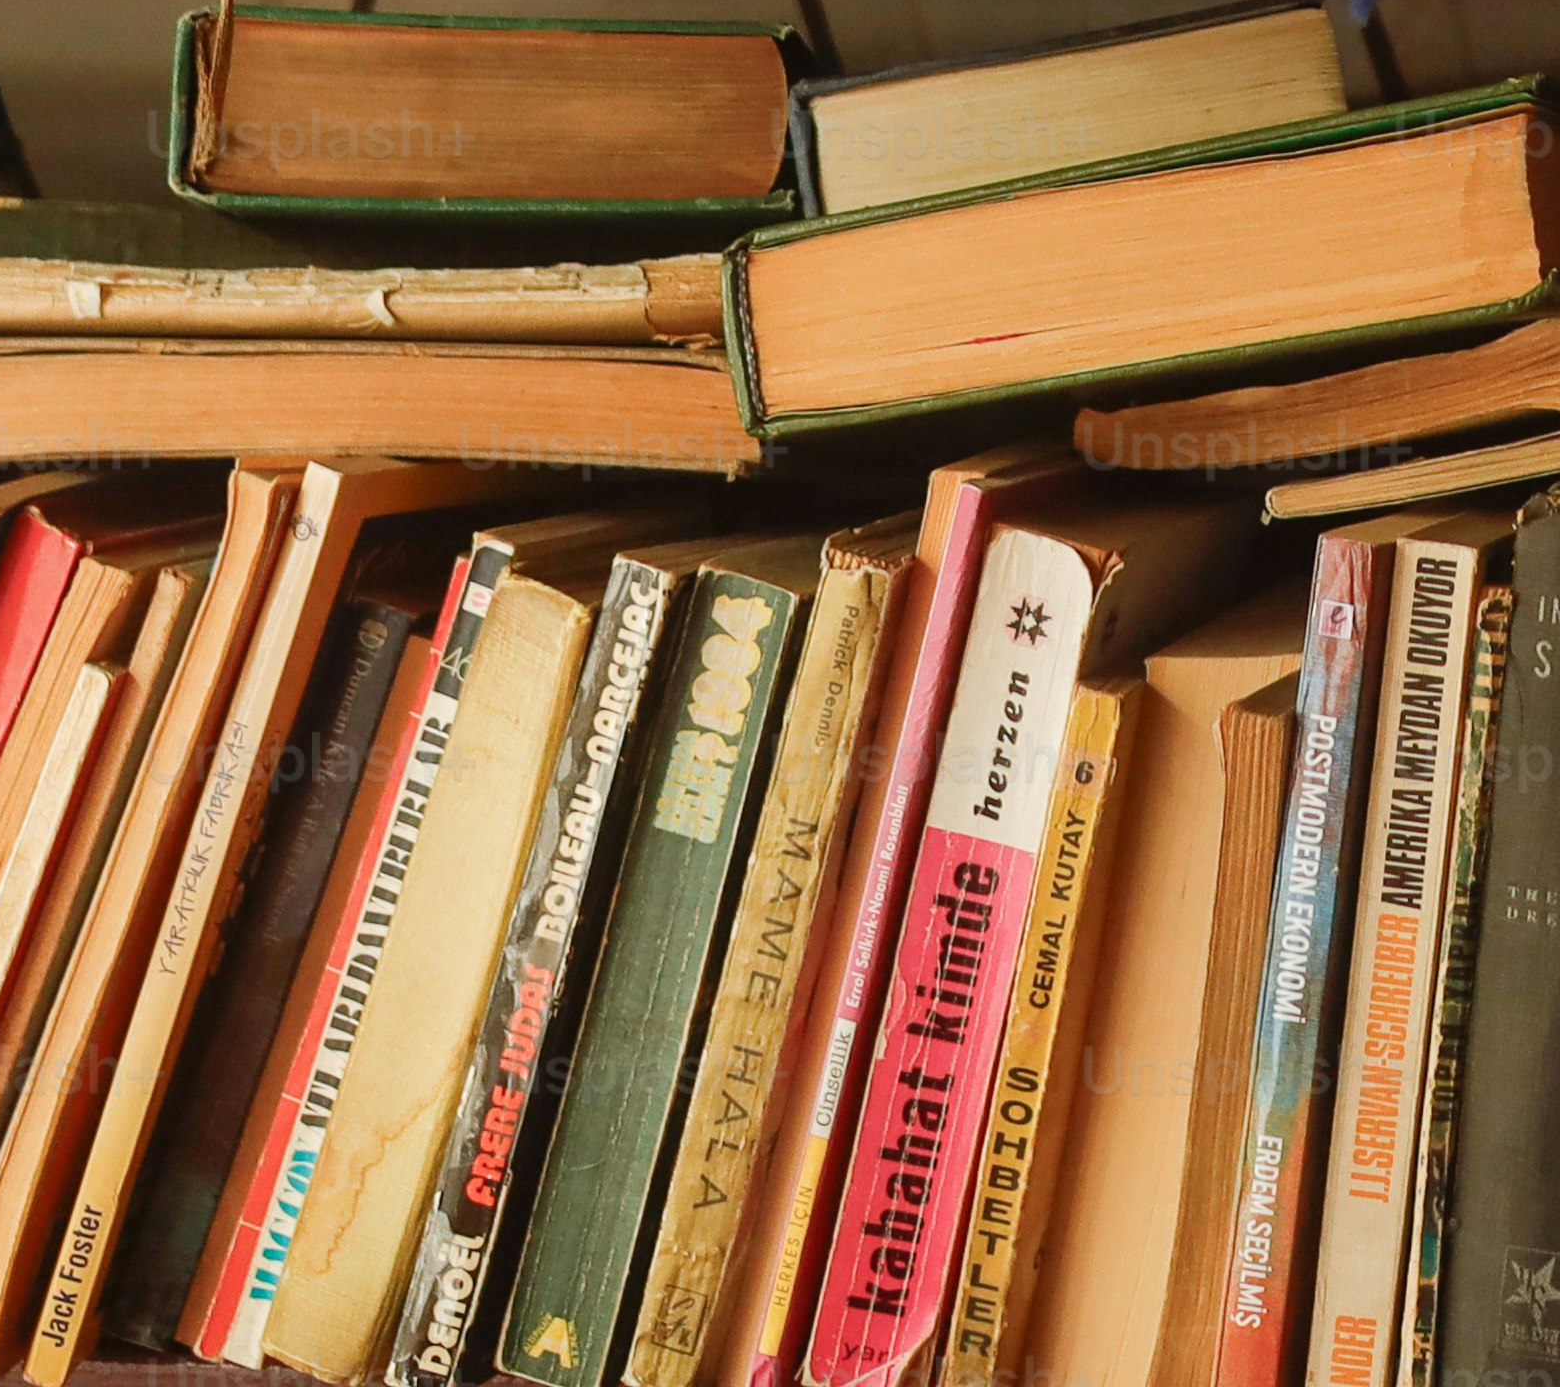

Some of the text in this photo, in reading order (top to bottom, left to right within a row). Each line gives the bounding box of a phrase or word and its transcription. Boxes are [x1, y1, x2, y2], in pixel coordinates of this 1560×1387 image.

[974, 671, 1029, 821] herzen
[1382, 556, 1459, 910] AMERİKA MEYDAN OKUYOR
[1029, 811, 1086, 1008] CEMAL KUTAY
[816, 1027, 851, 1128] Cinsellik
[846, 862, 998, 1316] kabahat kimde
[45, 1203, 104, 1349] Jack Foster
[956, 1068, 1039, 1357] SOHBETLER
